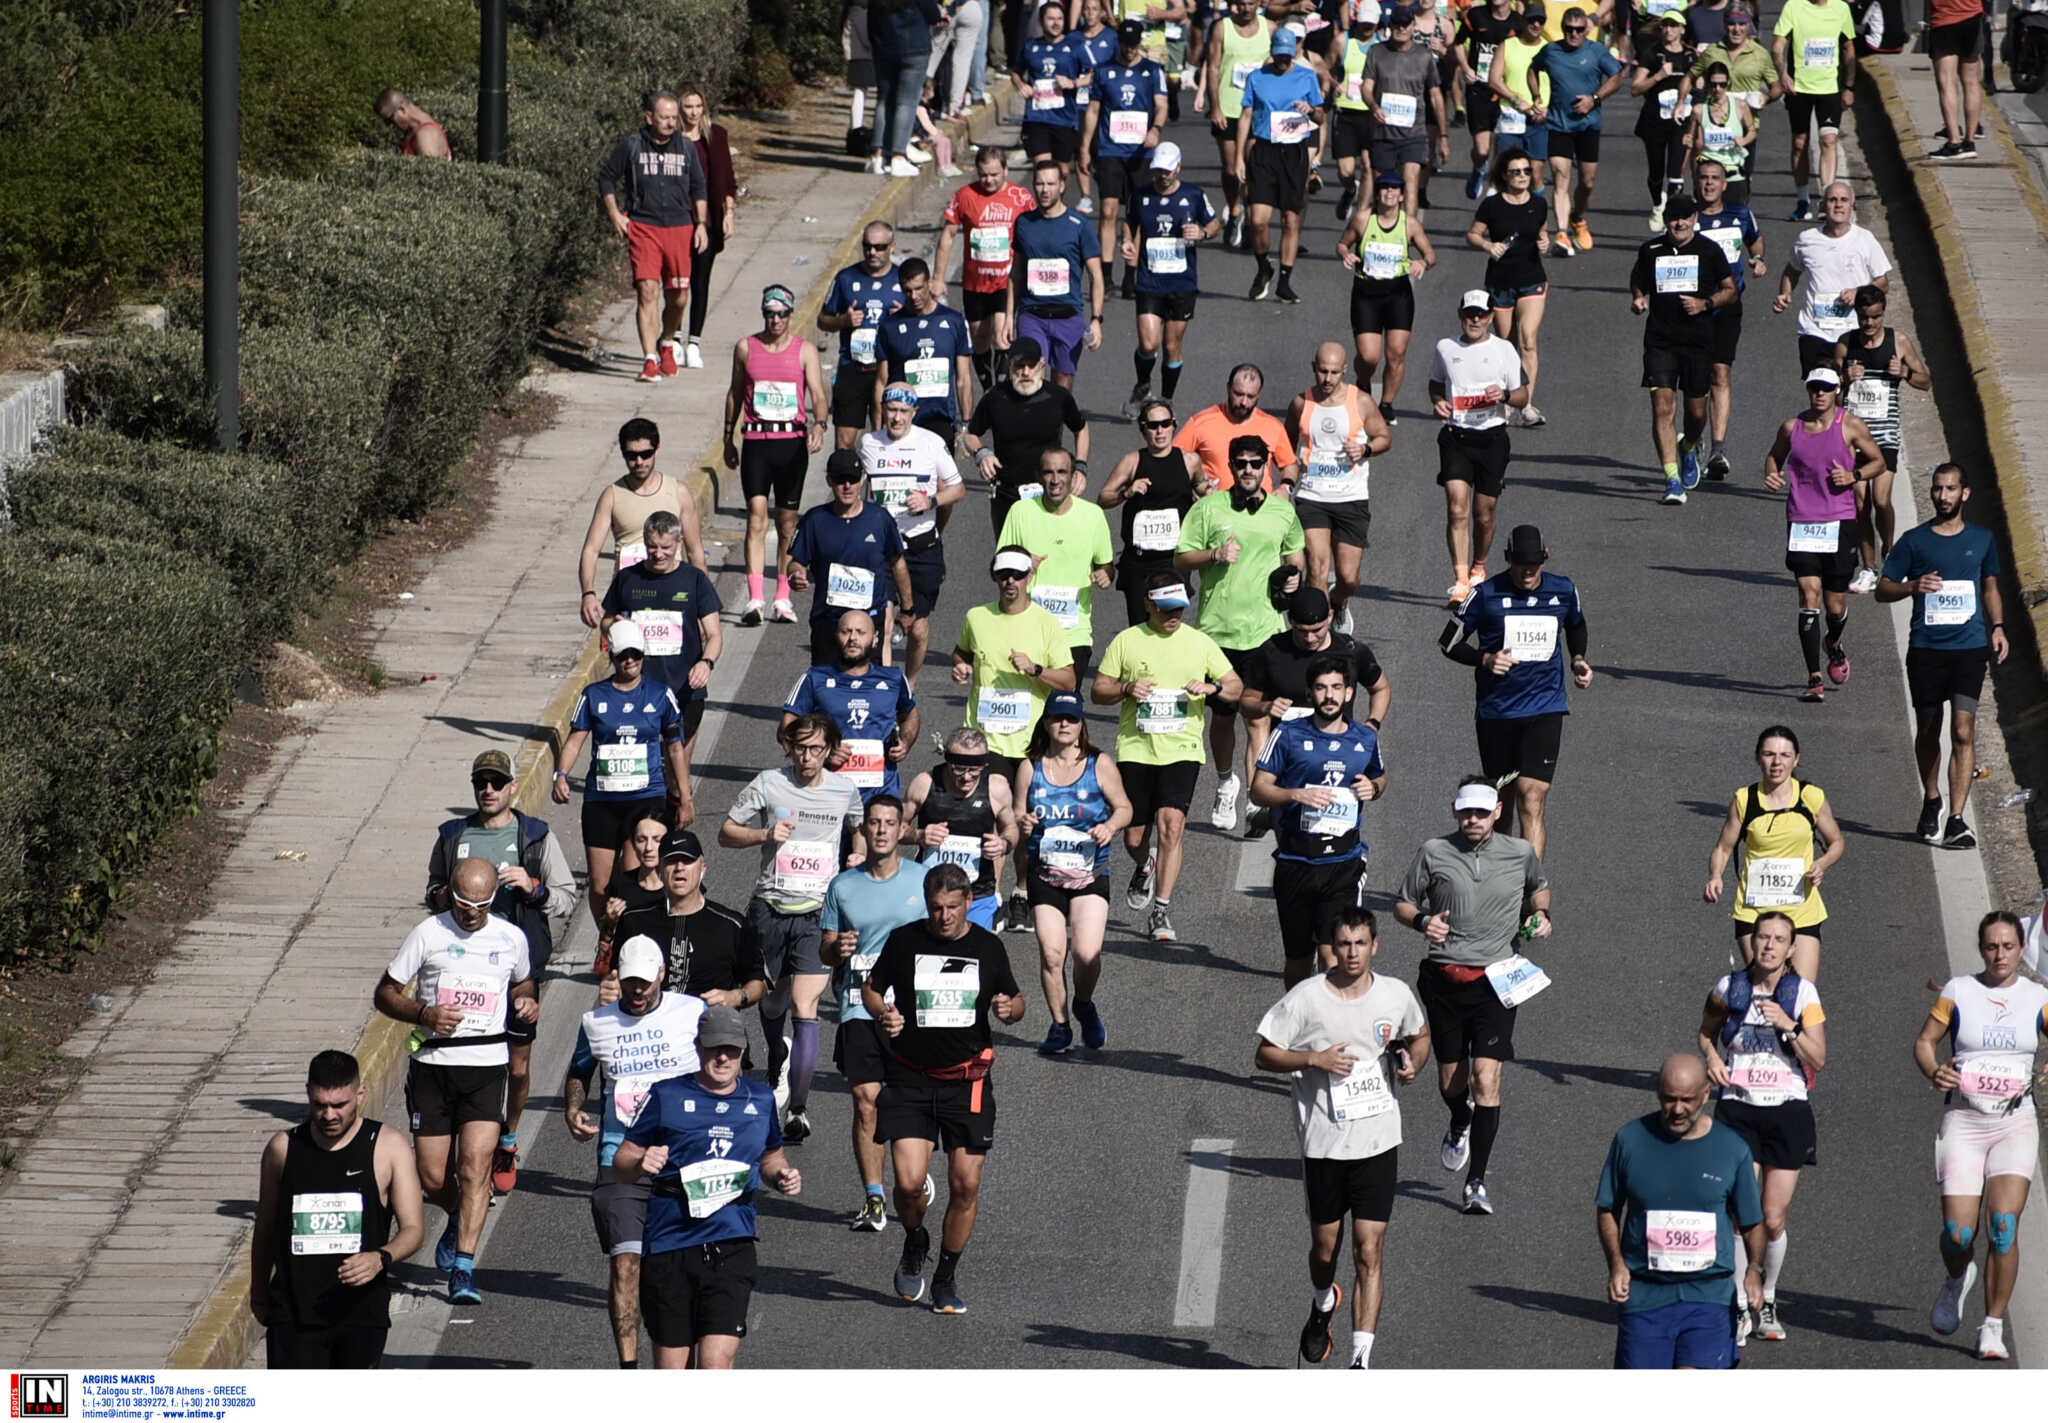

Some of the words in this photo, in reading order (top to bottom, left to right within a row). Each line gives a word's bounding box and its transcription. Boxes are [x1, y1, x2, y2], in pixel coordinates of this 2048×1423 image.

[1667, 266, 1688, 277] 9167
[1318, 465, 1342, 477] 9089
[1143, 523, 1172, 535] 11730
[1803, 525, 1827, 536] 9474
[838, 577, 866, 593] 10256
[1938, 595, 1964, 607] 9561
[643, 625, 669, 638] 6584
[1516, 631, 1547, 643] 11544
[991, 702, 1017, 716] 9601
[607, 759, 636, 773] 8108
[1055, 840, 1083, 853] 9156
[791, 858, 820, 871] 6256
[936, 851, 970, 864] 10147
[1760, 874, 1795, 888] 11852
[454, 991, 485, 1007] 5290
[930, 990, 963, 1005] 7635
[616, 1031, 642, 1044] run
[646, 1028, 663, 1040] to
[612, 1042, 670, 1060] change
[609, 1056, 678, 1076] diabetes
[1344, 1077, 1382, 1097] 15482
[1978, 1076, 2009, 1092] 5525
[701, 1174, 736, 1194] 7732
[310, 1212, 346, 1229] 8795
[1665, 1231, 1699, 1246] 5985
